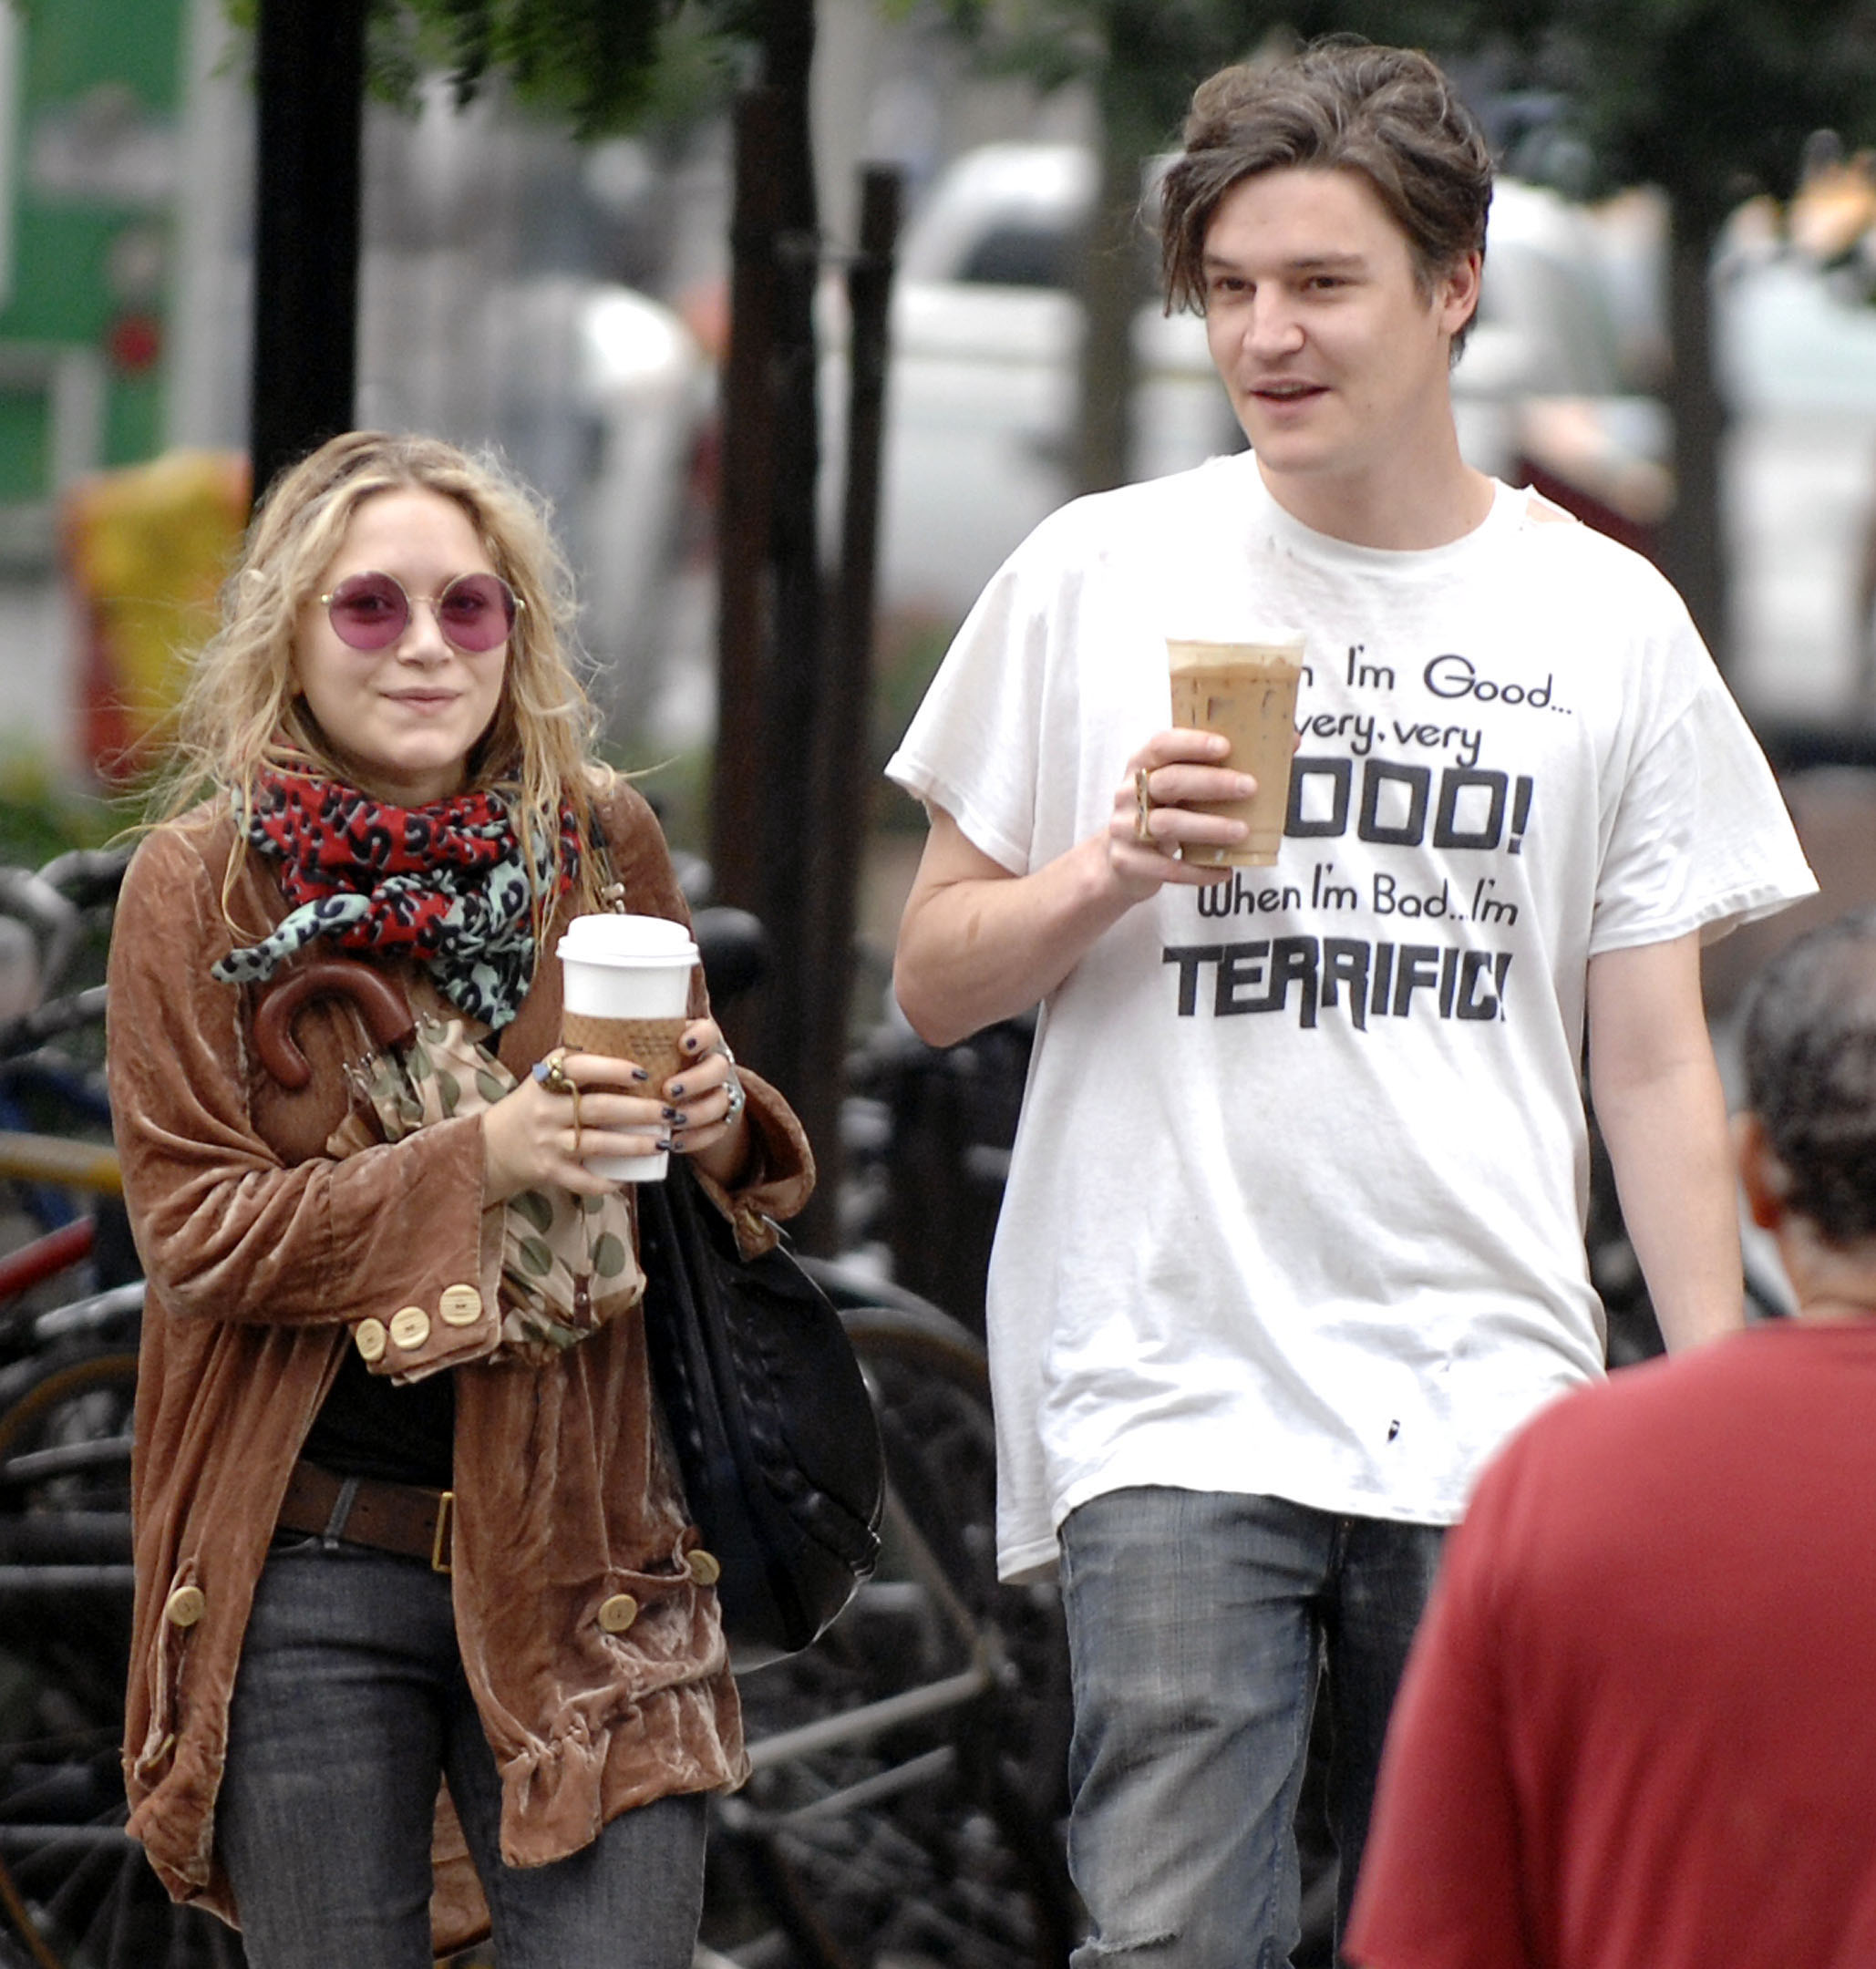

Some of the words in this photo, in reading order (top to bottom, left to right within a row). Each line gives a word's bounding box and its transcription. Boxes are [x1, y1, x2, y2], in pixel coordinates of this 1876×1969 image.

[1346, 644, 1395, 691] I'm
[1423, 654, 1572, 715] Good...
[1283, 756, 1533, 855] OOD!
[1197, 871, 1302, 918] When
[1312, 862, 1358, 911] I'm
[1162, 935, 1514, 1033] TERRIFIC!
